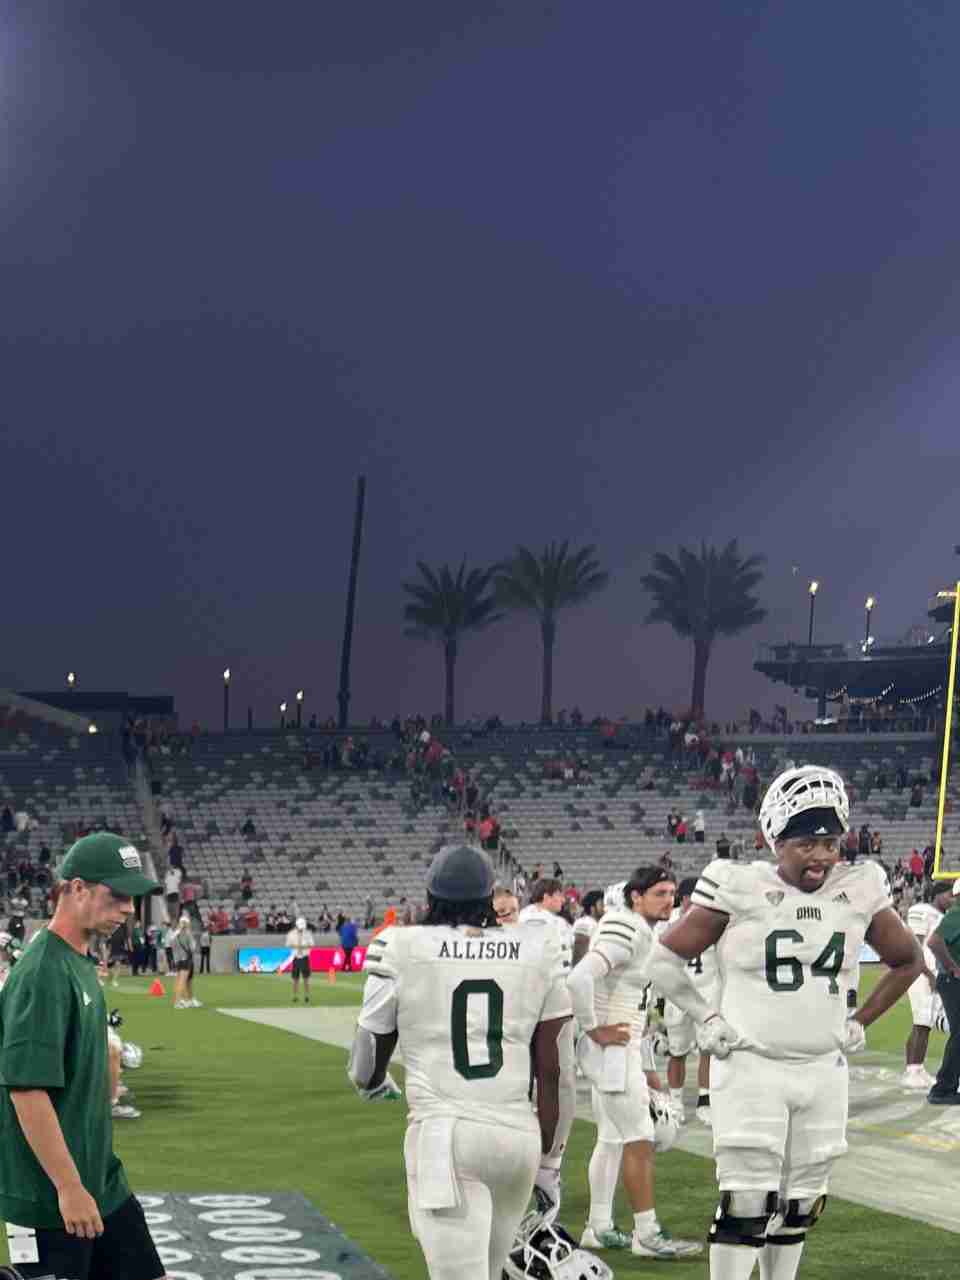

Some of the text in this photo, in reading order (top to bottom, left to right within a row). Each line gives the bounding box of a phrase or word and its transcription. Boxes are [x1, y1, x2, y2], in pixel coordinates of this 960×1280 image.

[796, 906, 823, 922] OHIO
[438, 940, 521, 960] ALLISON
[765, 929, 846, 995] 64
[451, 978, 504, 1081] 0
